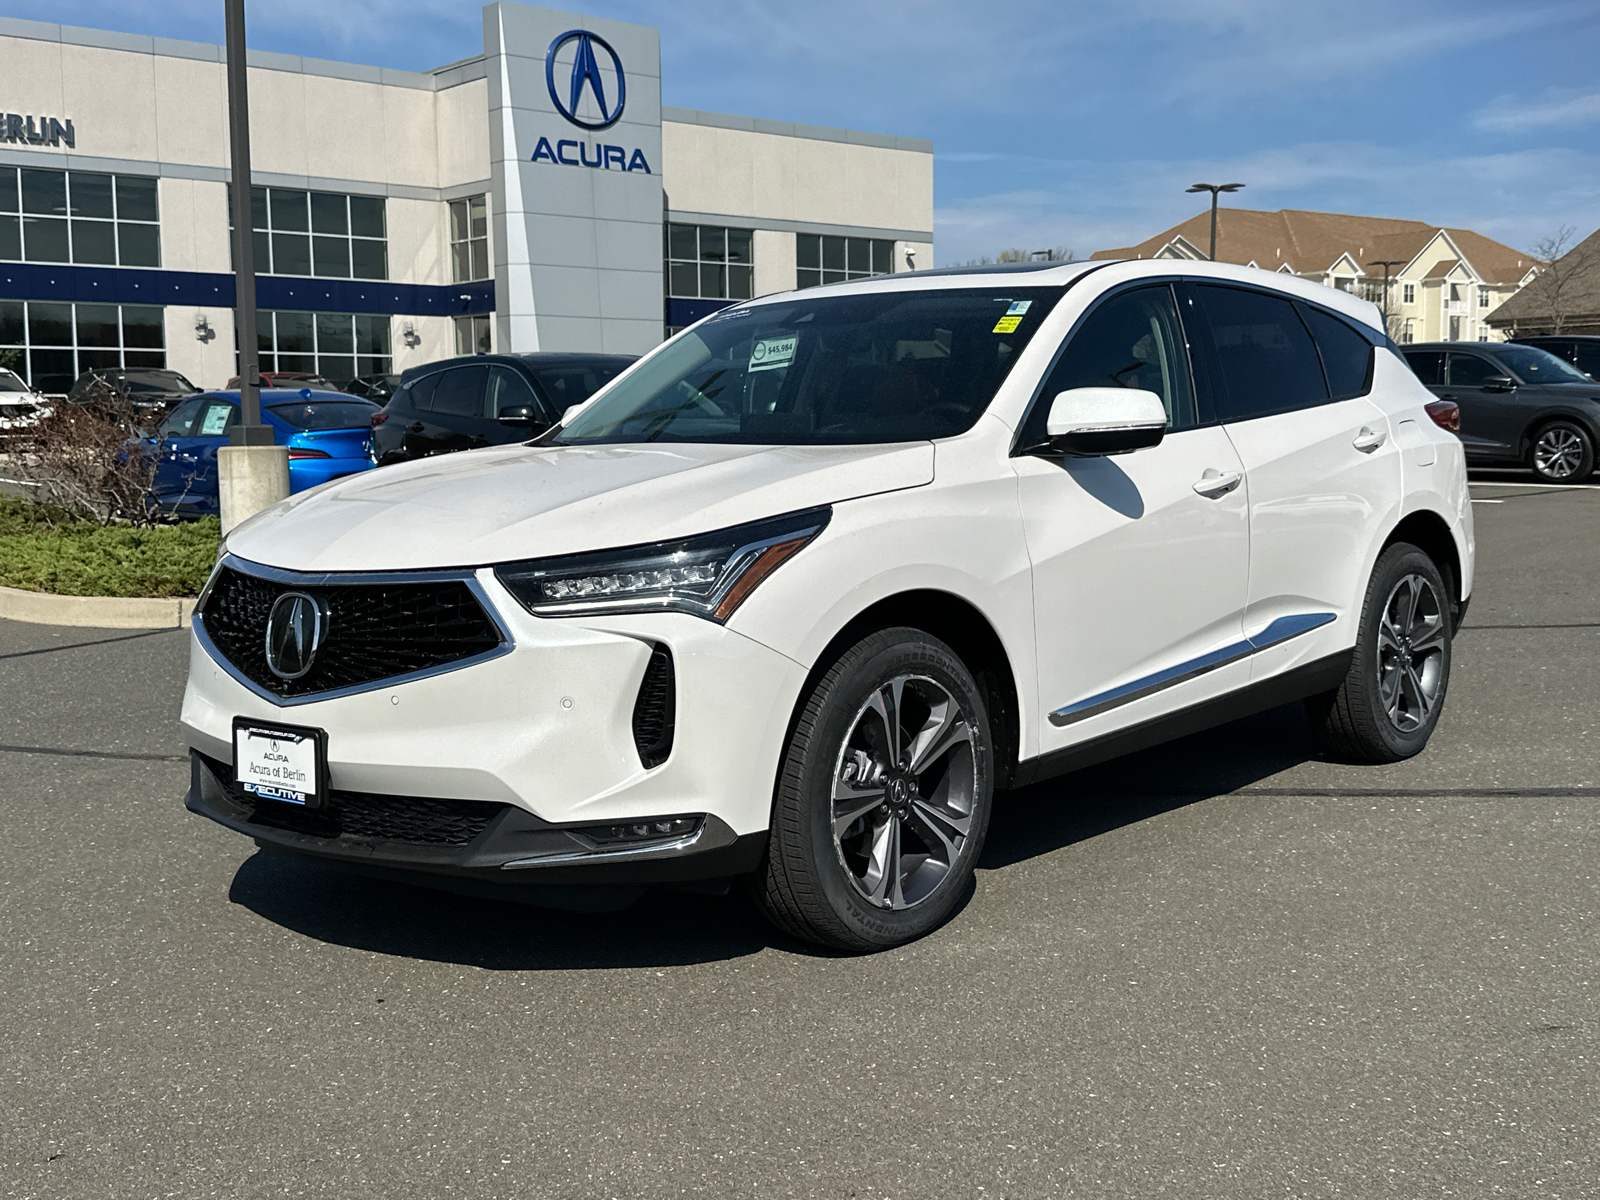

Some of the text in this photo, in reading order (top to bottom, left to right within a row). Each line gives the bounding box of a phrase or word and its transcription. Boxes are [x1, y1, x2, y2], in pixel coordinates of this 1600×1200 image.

[0, 112, 75, 148] RLIN
[531, 136, 651, 174] ACURA
[767, 343, 793, 355] $45,984
[263, 752, 290, 763] ACURA
[249, 761, 306, 782] Acura of Berlin
[243, 782, 306, 802] EXECUTIVE
